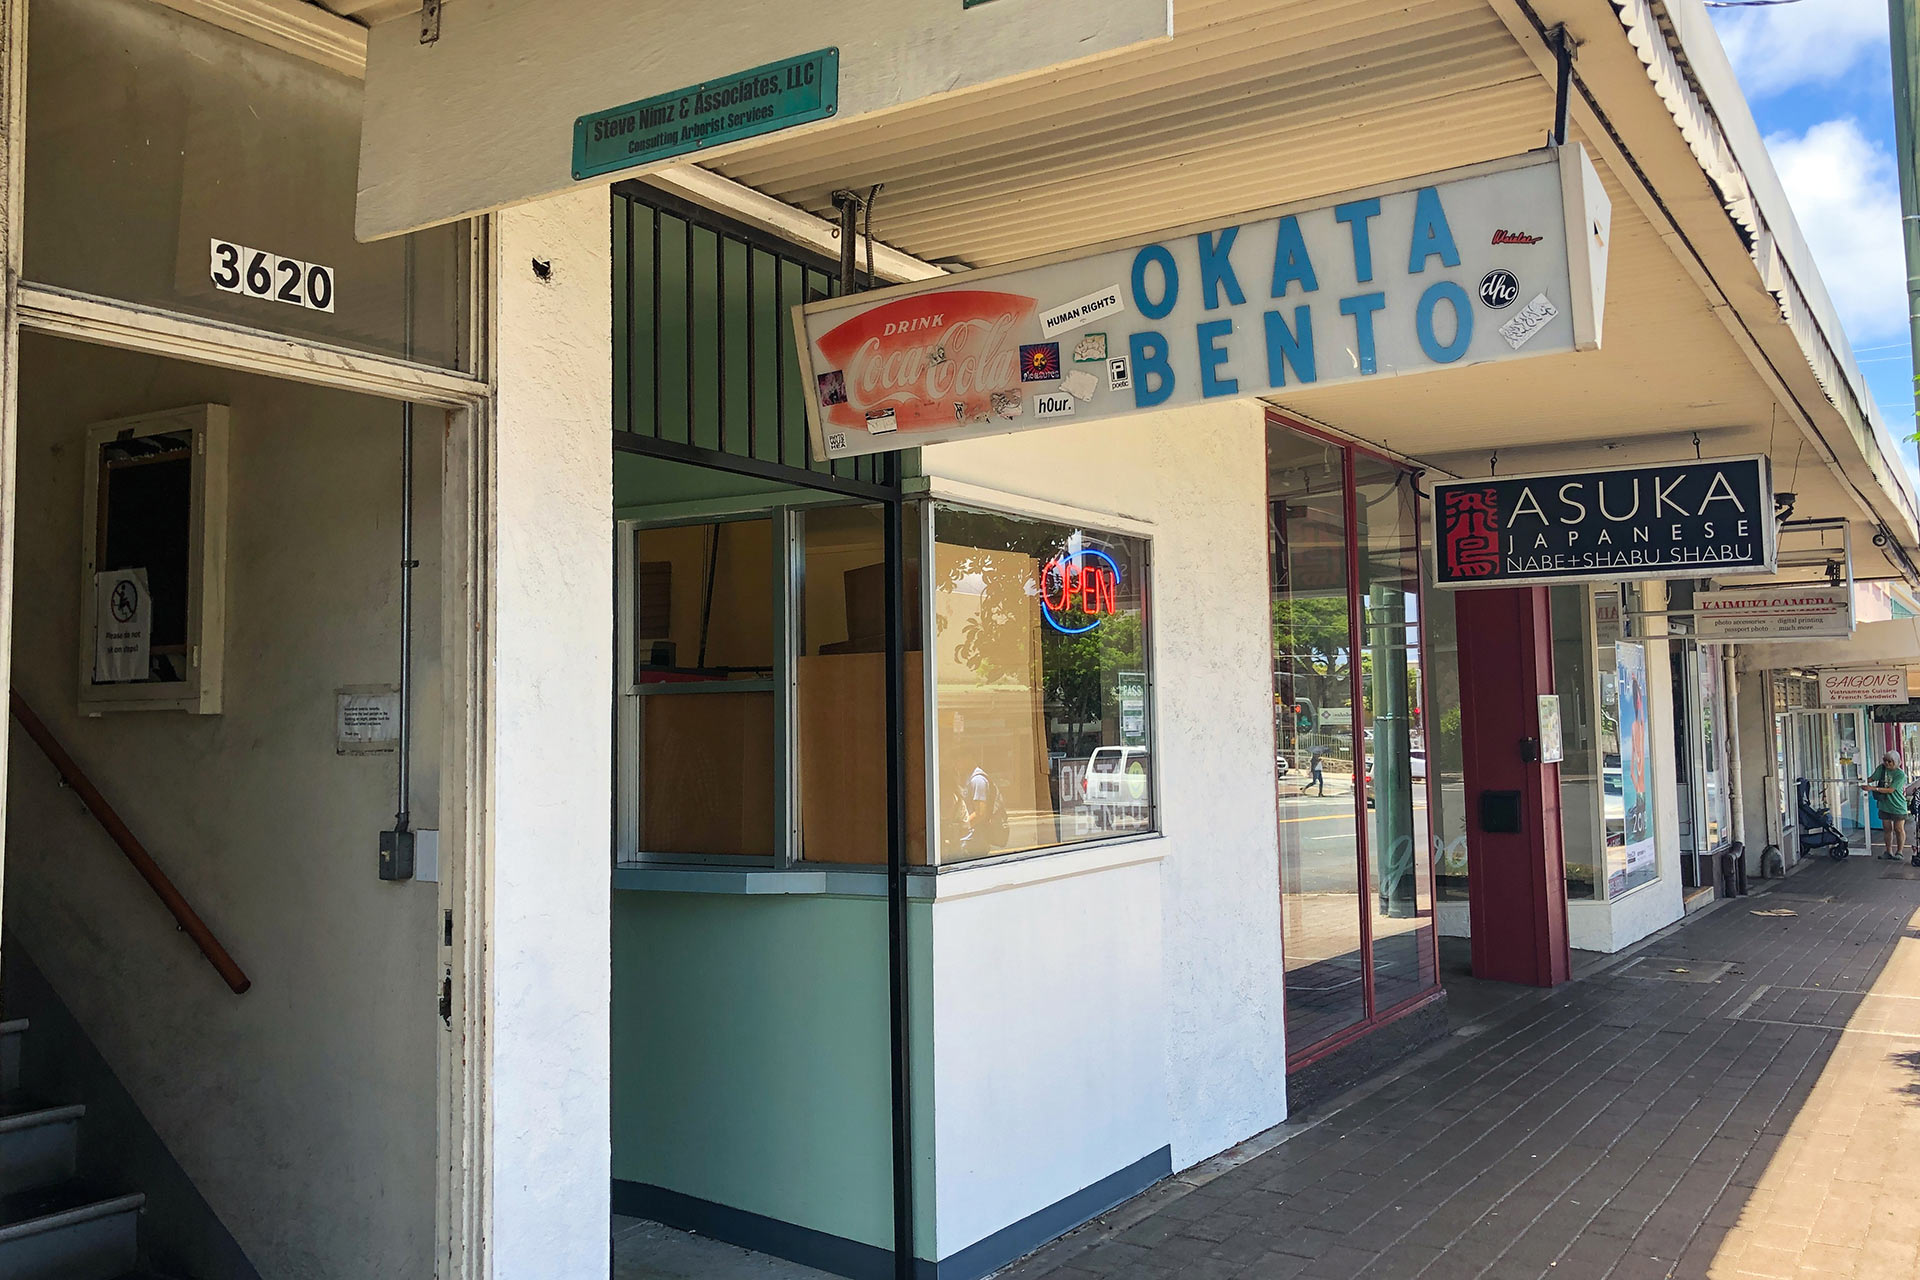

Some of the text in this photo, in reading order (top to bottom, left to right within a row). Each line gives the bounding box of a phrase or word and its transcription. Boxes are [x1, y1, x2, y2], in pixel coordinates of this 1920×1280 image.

[594, 62, 815, 142] Steve Nimz & Associates, LLC
[628, 104, 774, 154] Consulting Arborist Services
[1131, 186, 1462, 320] OKATA
[213, 243, 332, 309] 3620
[883, 313, 945, 337] DRINK
[1046, 295, 1116, 328] HUMAN RIGHTS
[1129, 281, 1474, 408] BENTO
[1111, 380, 1129, 390] poetic
[1506, 471, 1746, 529] ASUKA
[1507, 519, 1749, 555] JAPANESE
[1671, 543, 1752, 563] SHABU
[1041, 559, 1115, 615] OPEN
[1714, 618, 1732, 626] photo
[1777, 617, 1797, 625] digital
[1798, 617, 1823, 625] printing
[1750, 625, 1769, 633] photo
[1123, 684, 1143, 697] PASS
[1825, 674, 1900, 688] SAIGON'S
